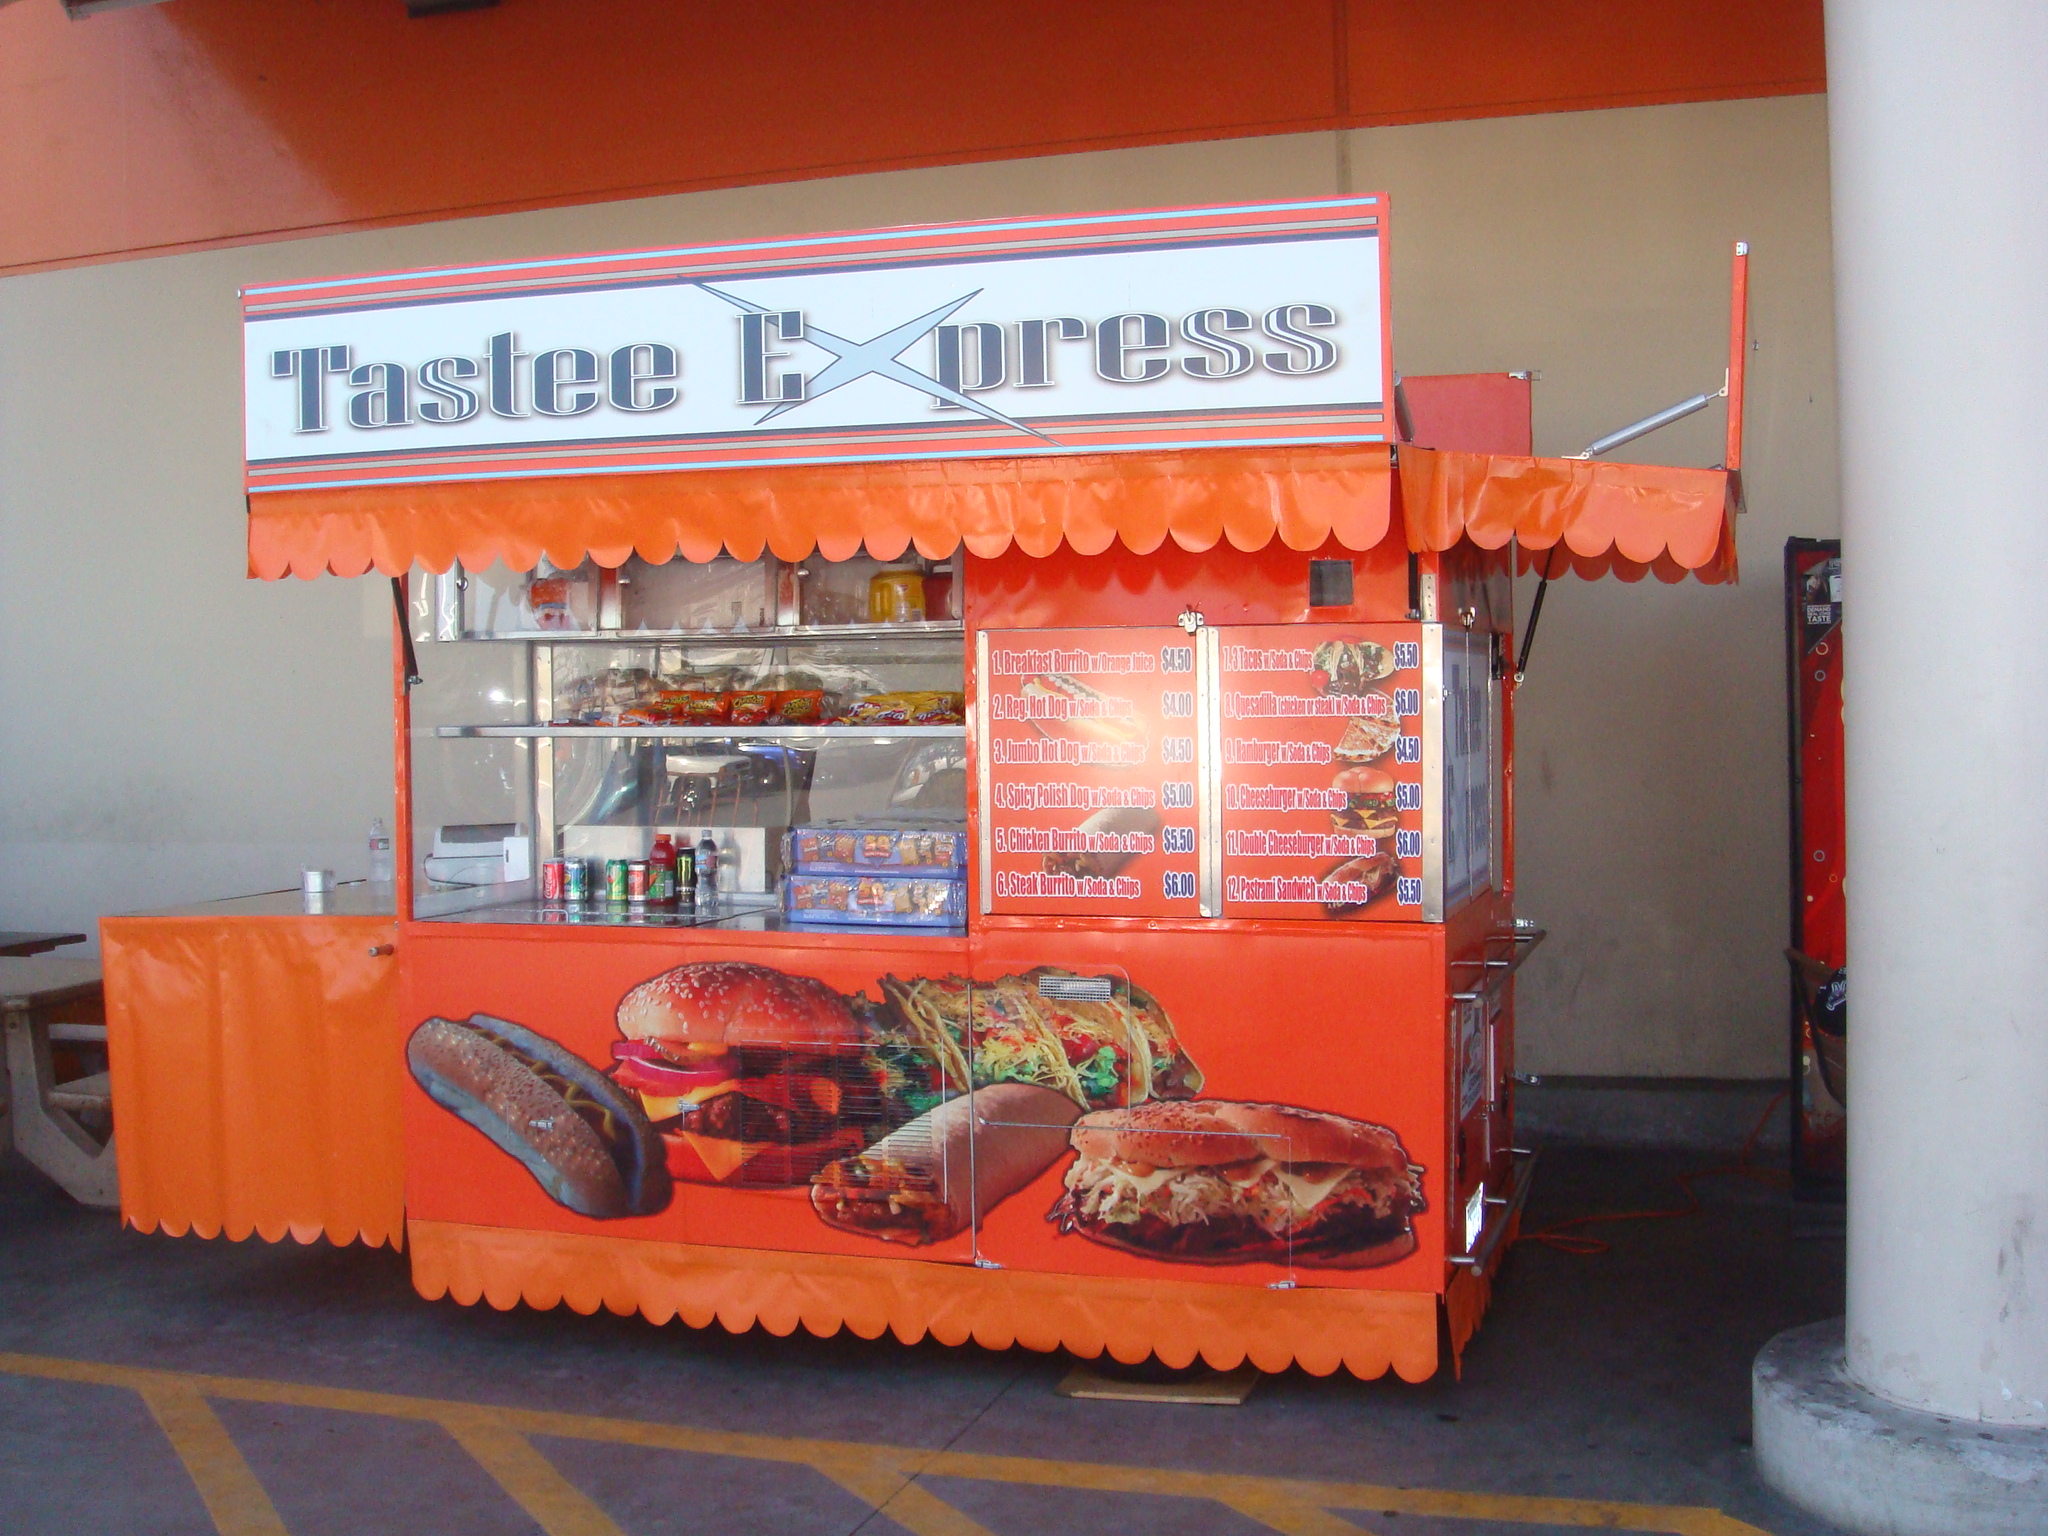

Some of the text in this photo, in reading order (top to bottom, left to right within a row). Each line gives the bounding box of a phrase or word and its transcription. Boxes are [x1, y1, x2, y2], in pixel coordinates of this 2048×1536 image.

[272, 330, 679, 433] Tastee
[992, 646, 1192, 675] 1. Breakfast Burrito w/Orange Juice $4.50
[1223, 641, 1418, 672] 7. 3 Tacos w/Soda & Chips $5.50
[993, 691, 1193, 721] 2. Reg. Hot Dog w/Soda & Chips $4.00
[1224, 692, 1234, 718] 8.
[1234, 691, 1277, 719] Quesadilla
[1307, 700, 1314, 716] or
[1336, 695, 1360, 717] w/Soda
[1361, 698, 1366, 717] &
[1367, 695, 1387, 718] Chips
[1394, 688, 1419, 717] $6.00
[994, 736, 1193, 765] 3. Jumbo Hot Dog w/Soda & Chips $4.50
[1225, 736, 1420, 765] 9. Hamburger w/Soda & Chips $4.50
[995, 781, 1193, 810] 4. Spicy Polish Dog w/Soda & Chips $5.00
[1226, 783, 1420, 812] 10. Cheeseburger w/Soda & Chips $5.00
[996, 827, 1194, 854] 5. Chicken Burrito w/Soda & Chips $5.50
[1226, 830, 1421, 858] 11. Double Cheeseburger w/Soda & Chips $6.00
[996, 872, 1195, 899] 6. Steak Burrito w/Soda & Chips $6.00
[1226, 876, 1422, 905] 12. Pastrami Sandwich w/Soda & Chips $5.50
